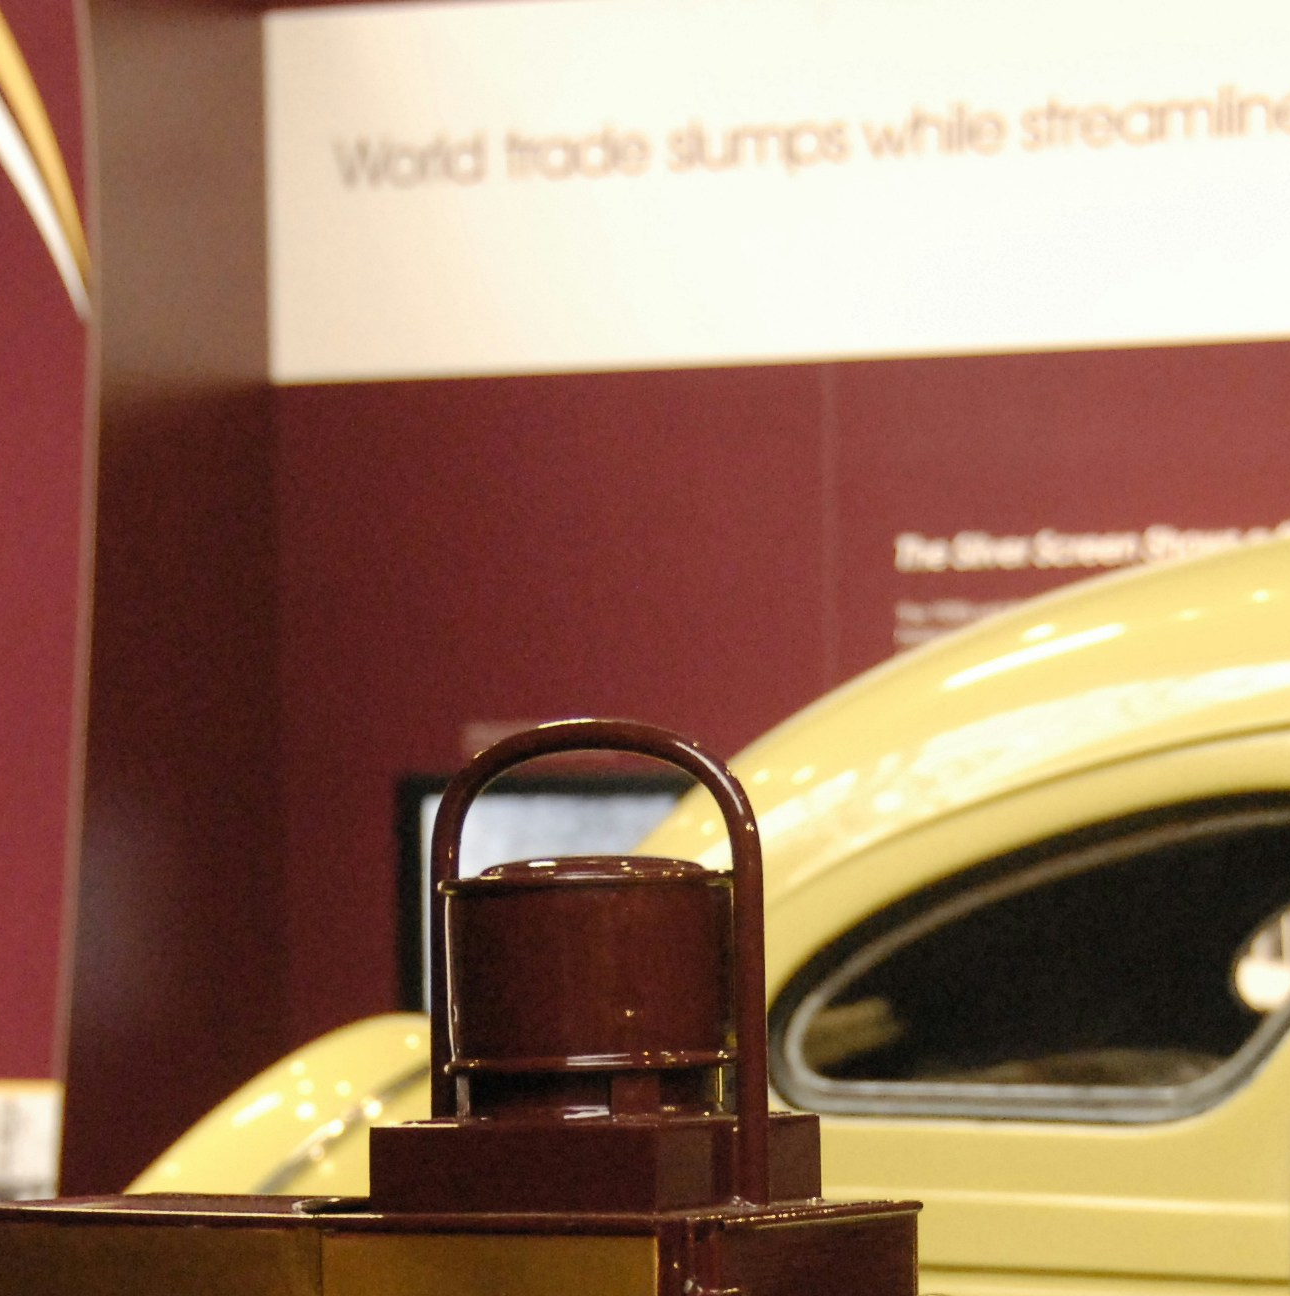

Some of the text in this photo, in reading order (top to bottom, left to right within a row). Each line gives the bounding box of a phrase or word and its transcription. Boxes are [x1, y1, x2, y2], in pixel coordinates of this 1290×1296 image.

[332, 130, 487, 189] World
[505, 123, 653, 180] trade
[666, 119, 851, 176] slumps
[861, 101, 1009, 158] while
[895, 532, 949, 572] The
